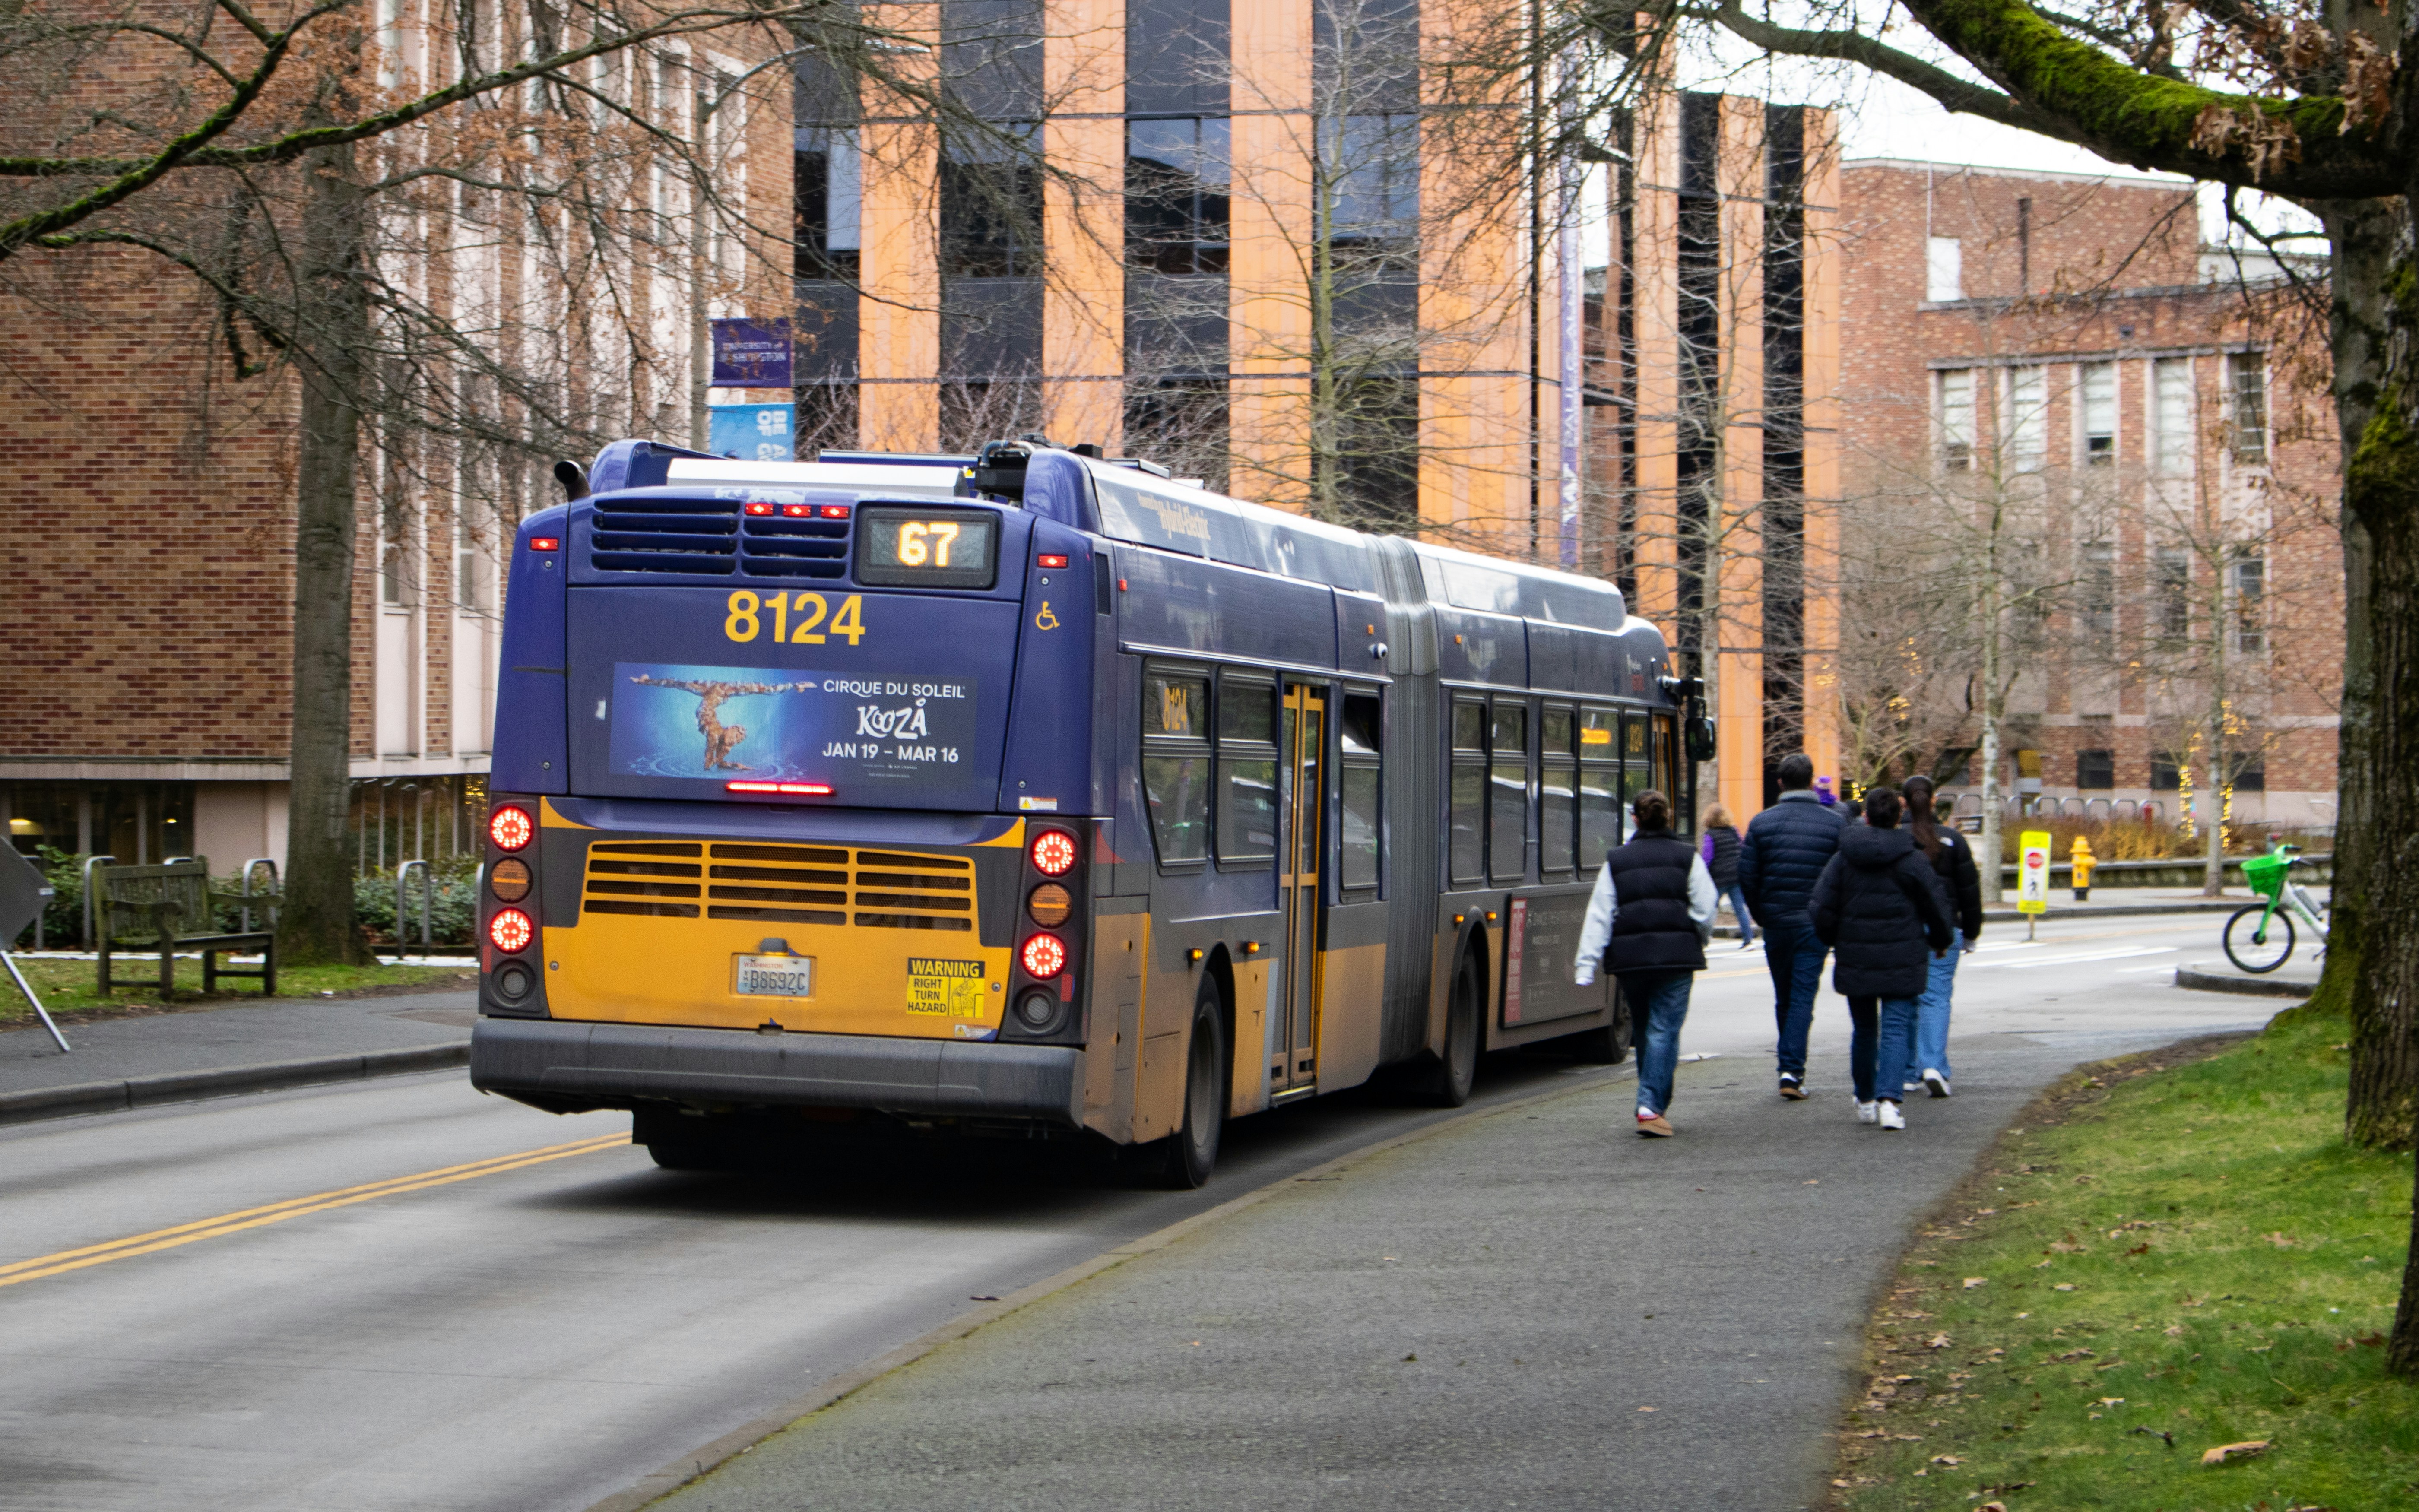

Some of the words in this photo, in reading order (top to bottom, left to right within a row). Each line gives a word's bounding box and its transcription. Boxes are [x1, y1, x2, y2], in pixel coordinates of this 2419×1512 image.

[718, 352, 787, 362] WSHNGTON
[757, 410, 772, 437] OF
[772, 410, 787, 435] BE
[898, 521, 960, 567] 67
[725, 590, 866, 646] 8124
[823, 679, 882, 697] CIRQUE
[886, 682, 908, 696] DU
[822, 742, 856, 758] JAN
[861, 743, 879, 759] 19
[898, 745, 937, 761] MAR
[941, 747, 959, 763] 16
[911, 960, 980, 978] WARNING
[751, 970, 805, 990] B8692C
[914, 978, 942, 989] RIGHT
[915, 990, 940, 1001] TURN
[907, 1002, 947, 1013] HAZARD
